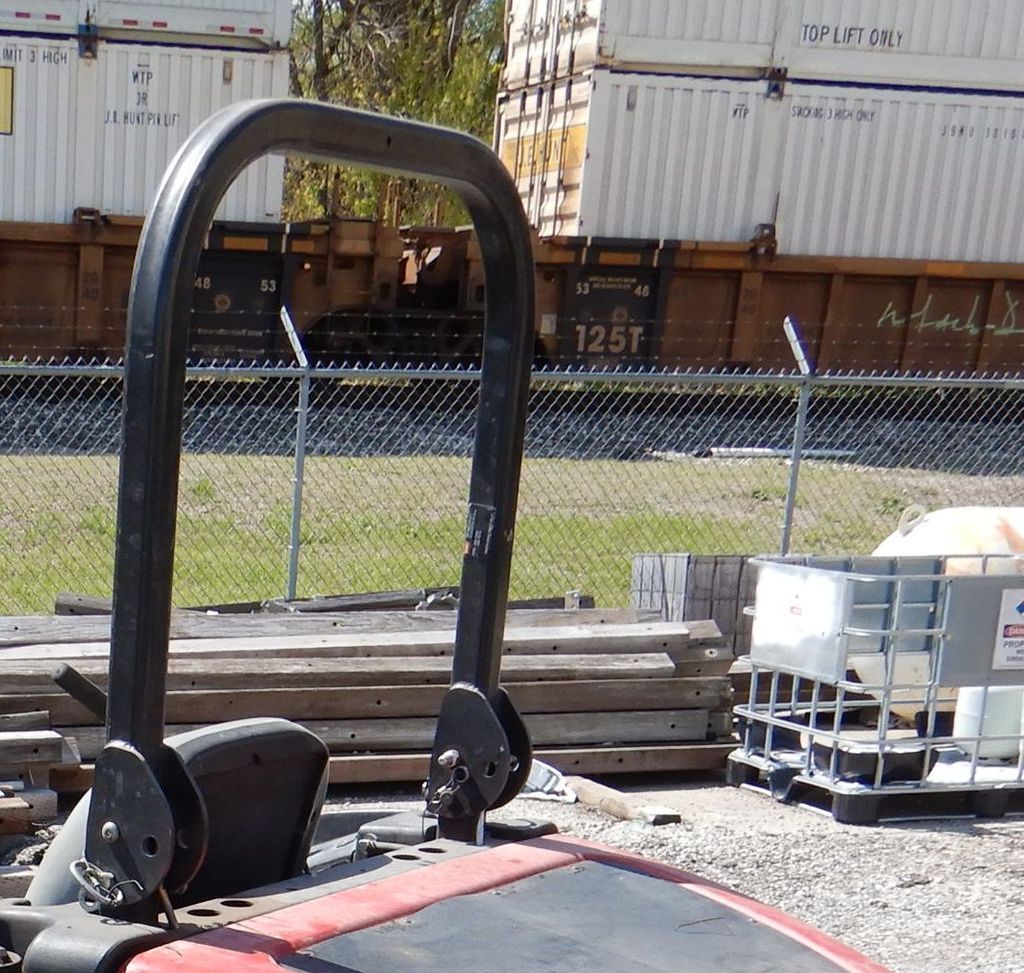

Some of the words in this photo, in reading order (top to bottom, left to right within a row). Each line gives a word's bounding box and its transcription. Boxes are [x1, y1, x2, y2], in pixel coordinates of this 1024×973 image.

[802, 24, 829, 42] TOP
[834, 26, 864, 45] LIFT
[870, 28, 903, 47] ONLY
[30, 52, 36, 63] 3
[43, 52, 67, 65] HIGH
[195, 277, 211, 289] 48
[260, 279, 276, 292] 53
[633, 285, 650, 297] 48
[576, 324, 643, 353] 125T
